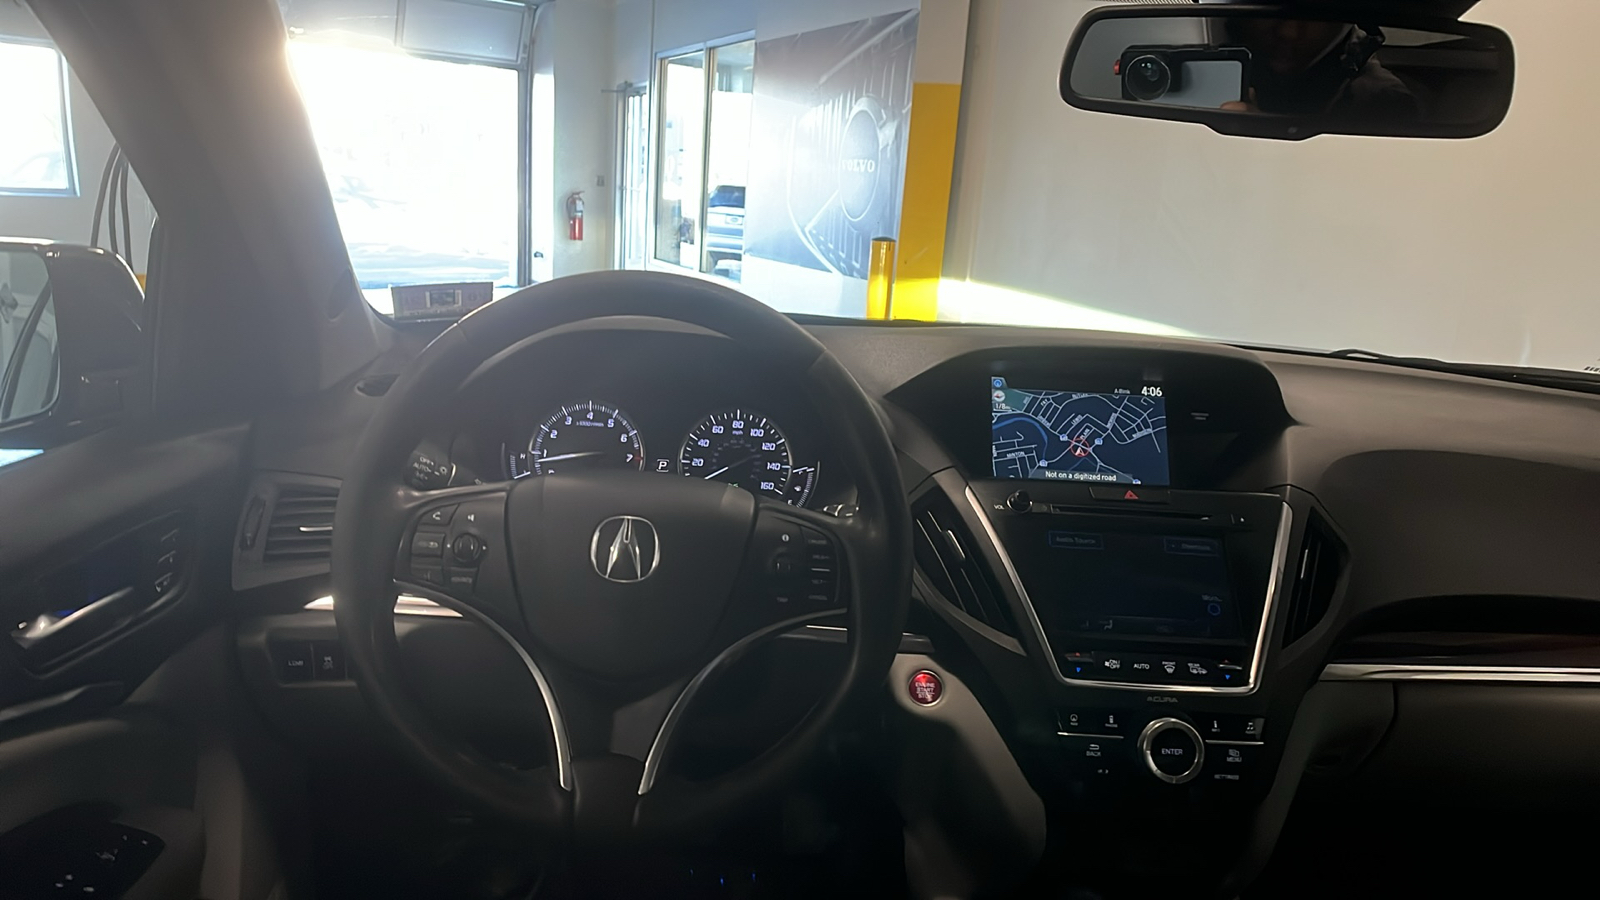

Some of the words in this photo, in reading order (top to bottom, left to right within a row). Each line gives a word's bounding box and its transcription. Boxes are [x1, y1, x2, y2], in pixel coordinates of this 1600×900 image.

[841, 158, 875, 173] VOLVO
[1141, 386, 1163, 397] 4:06
[586, 411, 594, 421] 4
[565, 416, 573, 426] 3
[607, 418, 615, 428] 5
[732, 420, 744, 429] 80
[550, 429, 558, 439] 2
[712, 425, 724, 434] 60
[750, 428, 764, 437] 100
[620, 433, 628, 443] 6
[697, 438, 710, 448] 40
[762, 442, 776, 451] 120
[626, 453, 633, 463] 7
[691, 458, 704, 467] 20
[658, 461, 668, 470] P
[767, 462, 781, 471] 140
[1073, 473, 1101, 481] digitized
[760, 481, 775, 490] 160
[1146, 695, 1179, 703] ACURA
[1161, 747, 1184, 756] ENTER
